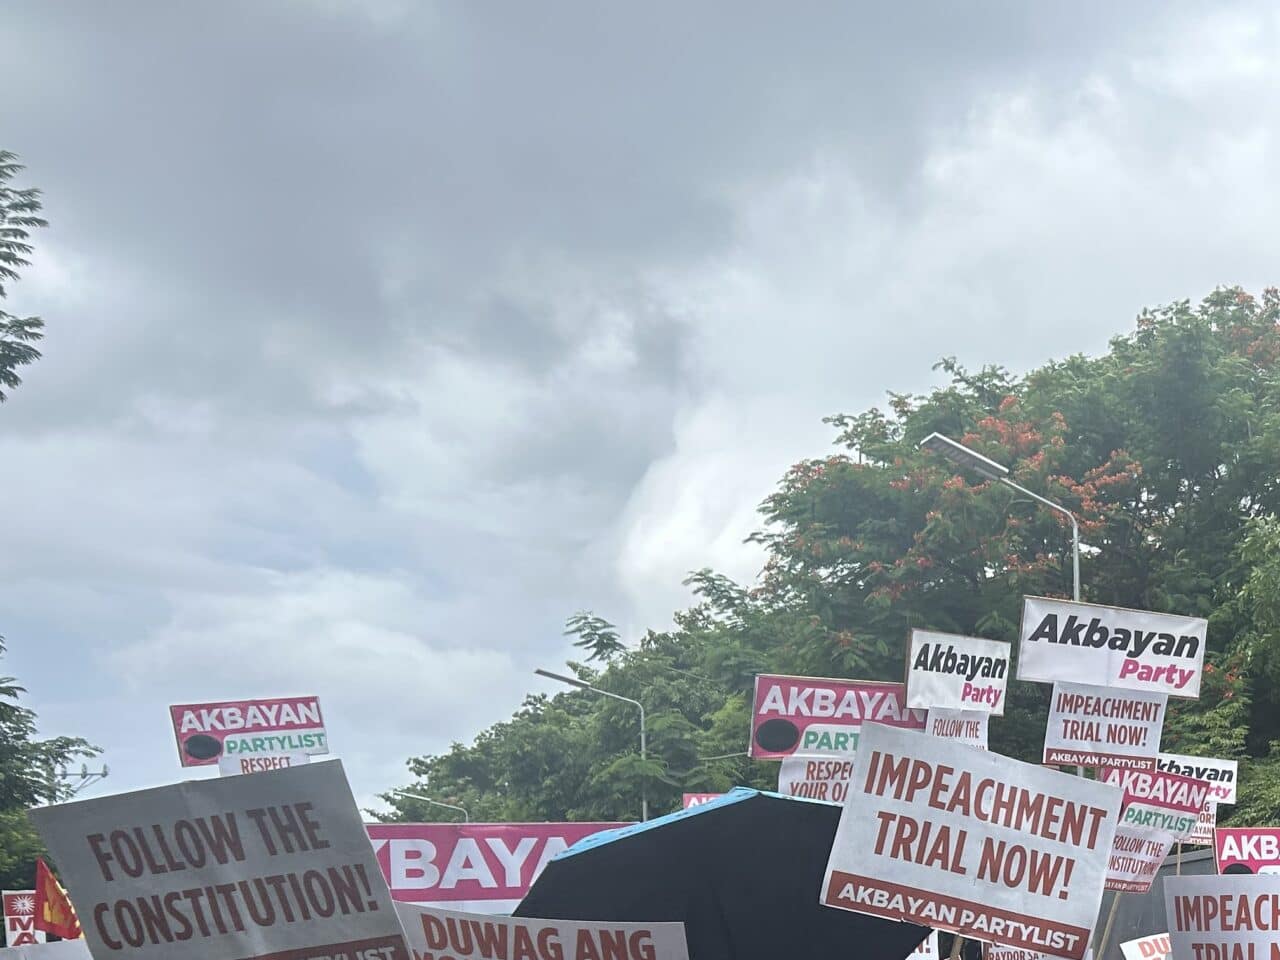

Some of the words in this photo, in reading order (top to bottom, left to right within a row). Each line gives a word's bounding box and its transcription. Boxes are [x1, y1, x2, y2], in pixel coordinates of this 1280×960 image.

[1029, 613, 1199, 659] Akbayan
[913, 643, 1007, 681] Akbayan
[1119, 658, 1195, 689] Party
[961, 682, 1003, 708] Party
[1056, 693, 1161, 722] IMPEACHMENT
[181, 702, 320, 733] AKBAYAN
[933, 719, 965, 738] FOLLOW
[965, 720, 980, 739] THE
[226, 733, 325, 754] PARTYLIST
[1062, 719, 1102, 743] TRIAL
[1106, 723, 1148, 747] NOW!
[806, 761, 852, 782] RESPE
[1050, 752, 1100, 766] AKBAYAN
[1101, 757, 1152, 771] PARTYLIST
[1157, 759, 1234, 783] kbayan
[864, 751, 1108, 850] IMPEACHMENT
[1105, 769, 1207, 809] AKBAYAN
[1124, 807, 1196, 833] PARTYLIST
[87, 813, 246, 882] FOLLOW
[247, 802, 331, 856] THE
[874, 811, 968, 875] TRIAL
[977, 837, 1075, 900] NOW!
[1113, 835, 1146, 855] FOLLOW
[1146, 841, 1164, 858] THE
[93, 863, 380, 950] CONSTITUTION!
[838, 883, 956, 924] AKBAYAN
[960, 909, 1079, 952] PARTYLIST
